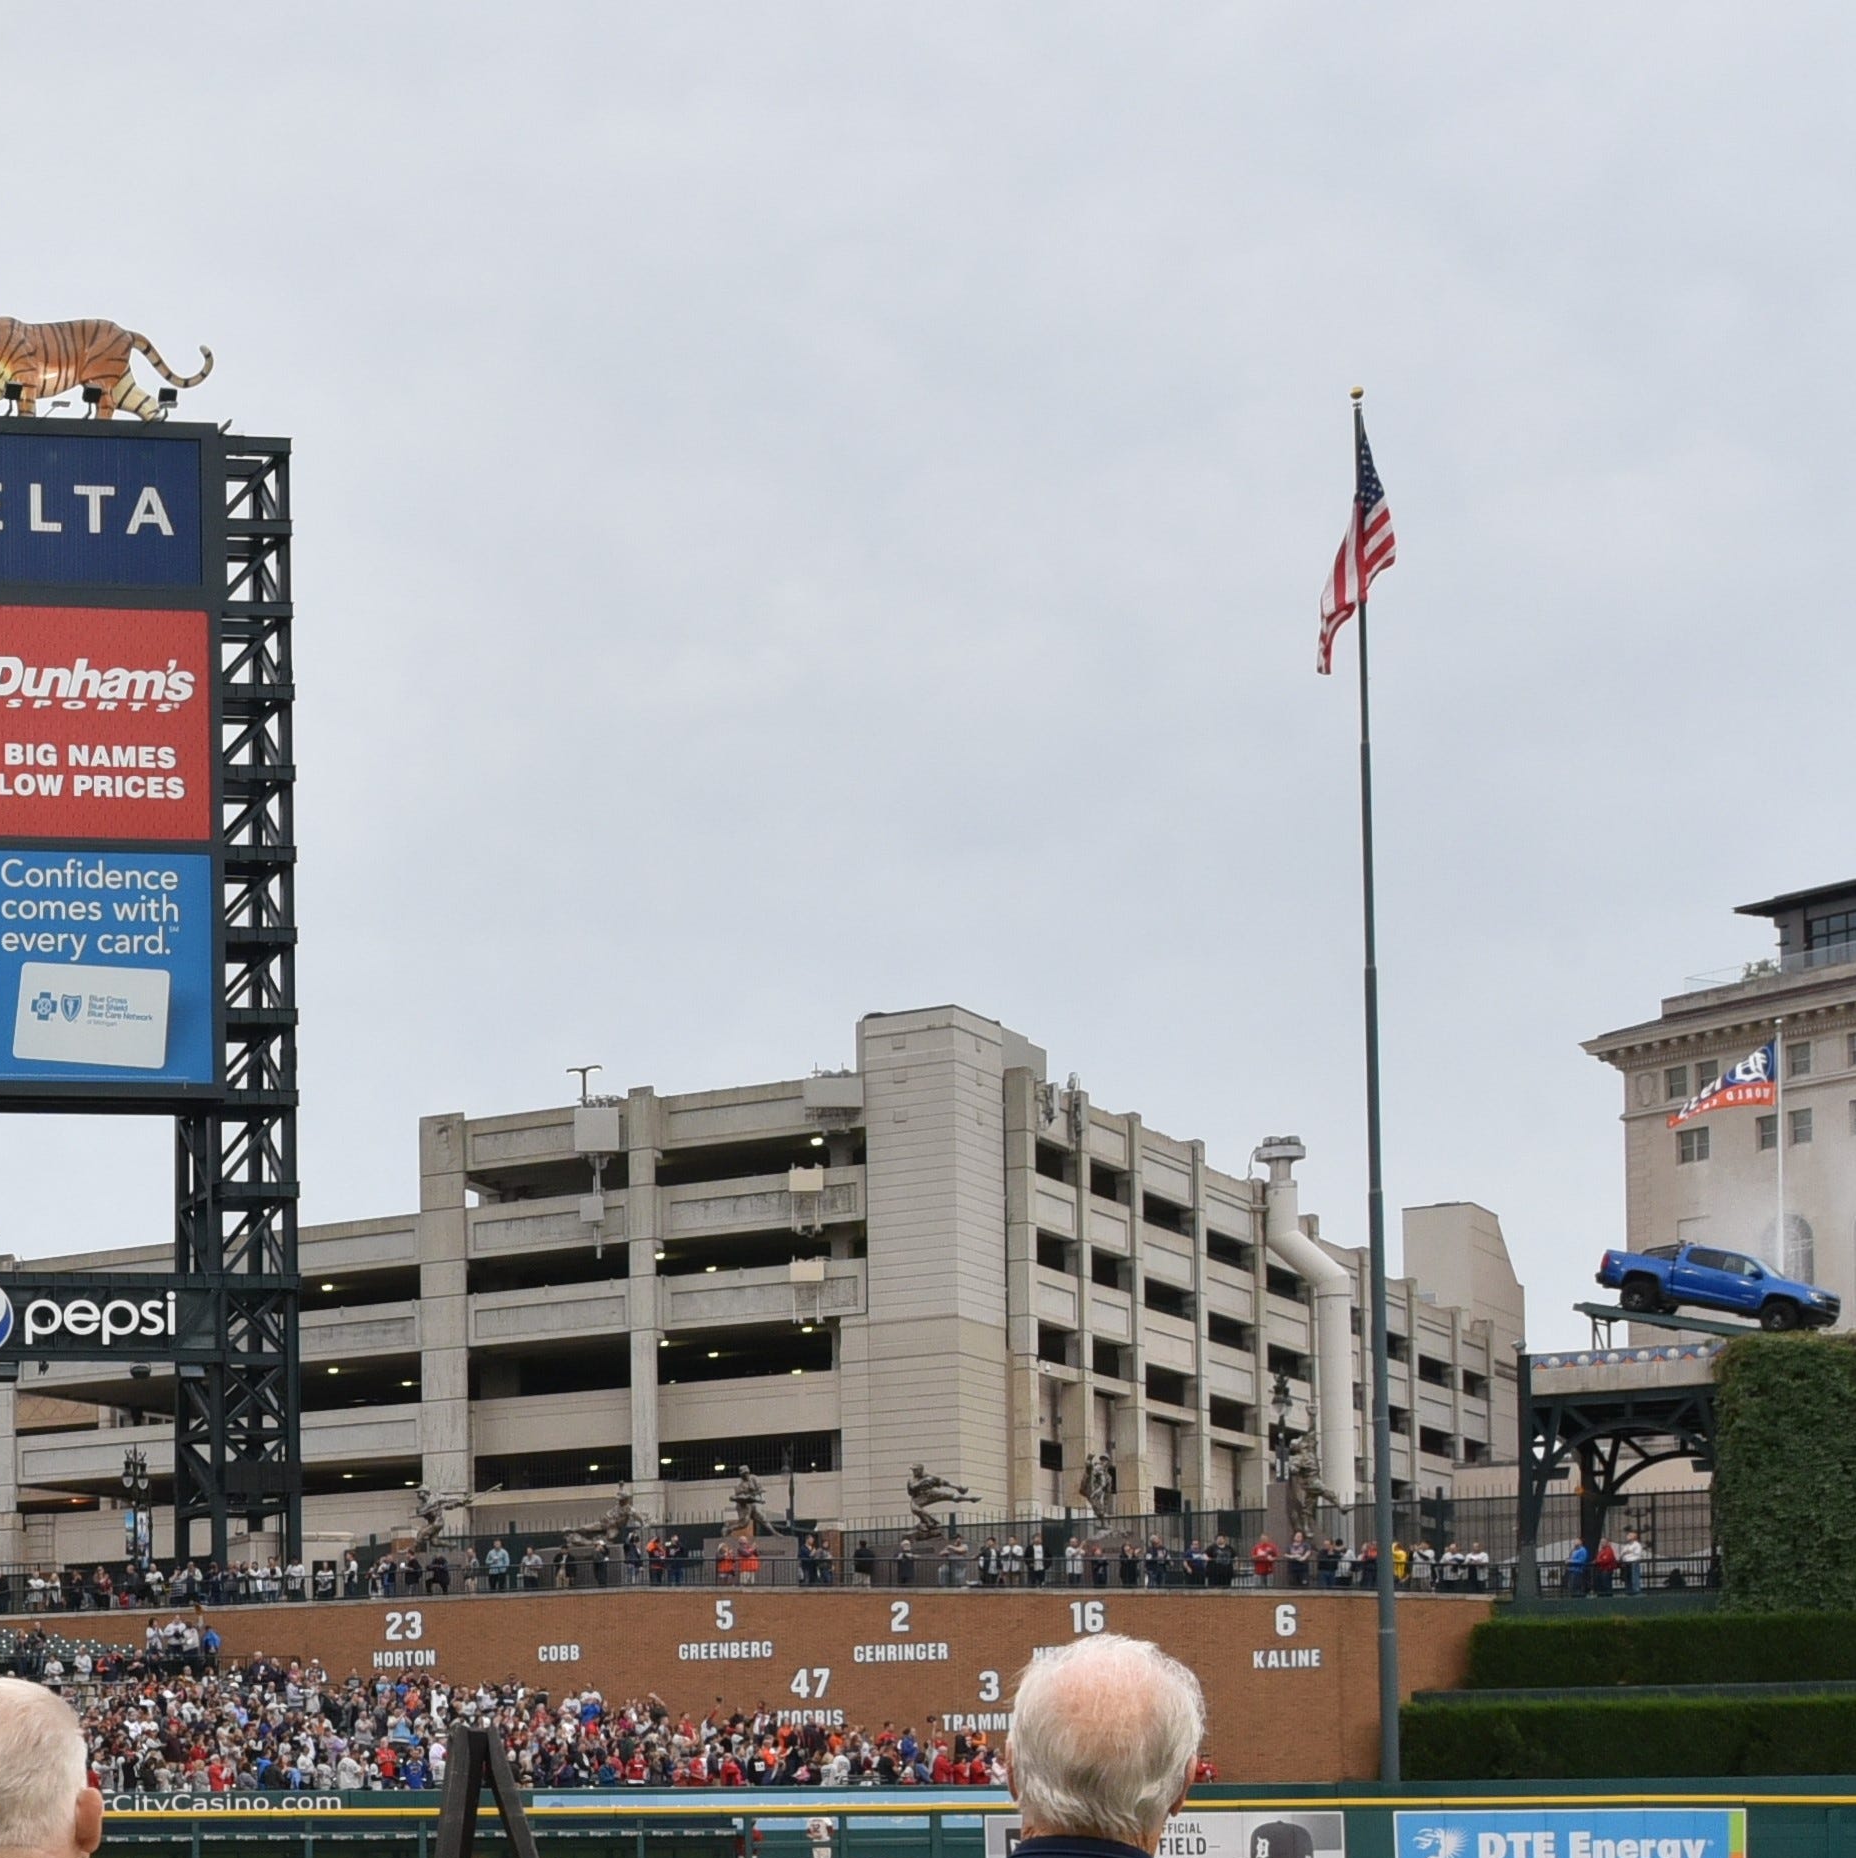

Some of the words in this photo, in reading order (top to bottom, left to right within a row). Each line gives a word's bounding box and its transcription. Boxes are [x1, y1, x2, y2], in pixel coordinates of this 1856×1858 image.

[6, 698, 173, 712] SPORTS
[4, 743, 58, 766] BIG
[68, 744, 176, 769] NAMES
[73, 774, 185, 800] PRICES
[0, 858, 179, 890] Confidence
[1, 900, 102, 921] comes
[113, 893, 179, 922] with
[1, 931, 87, 961] every
[97, 925, 171, 955] card.
[24, 1291, 176, 1345] pepsi
[386, 1611, 422, 1641] 23
[715, 1600, 734, 1631] 5
[890, 1602, 910, 1632] 2
[1069, 1601, 1104, 1633] 16
[1275, 1604, 1296, 1637] 6
[373, 1649, 436, 1668] HORTON
[538, 1644, 580, 1663] COBB
[678, 1641, 772, 1661] GREENBERG
[853, 1642, 949, 1664] GEHRINGER
[1253, 1648, 1321, 1669] KALINE
[790, 1667, 829, 1698] 47
[978, 1671, 1000, 1702] 3
[942, 1713, 1016, 1732] TRAMM
[102, 1793, 342, 1812] rCityCasino.com
[1159, 1838, 1206, 1855] FIELD
